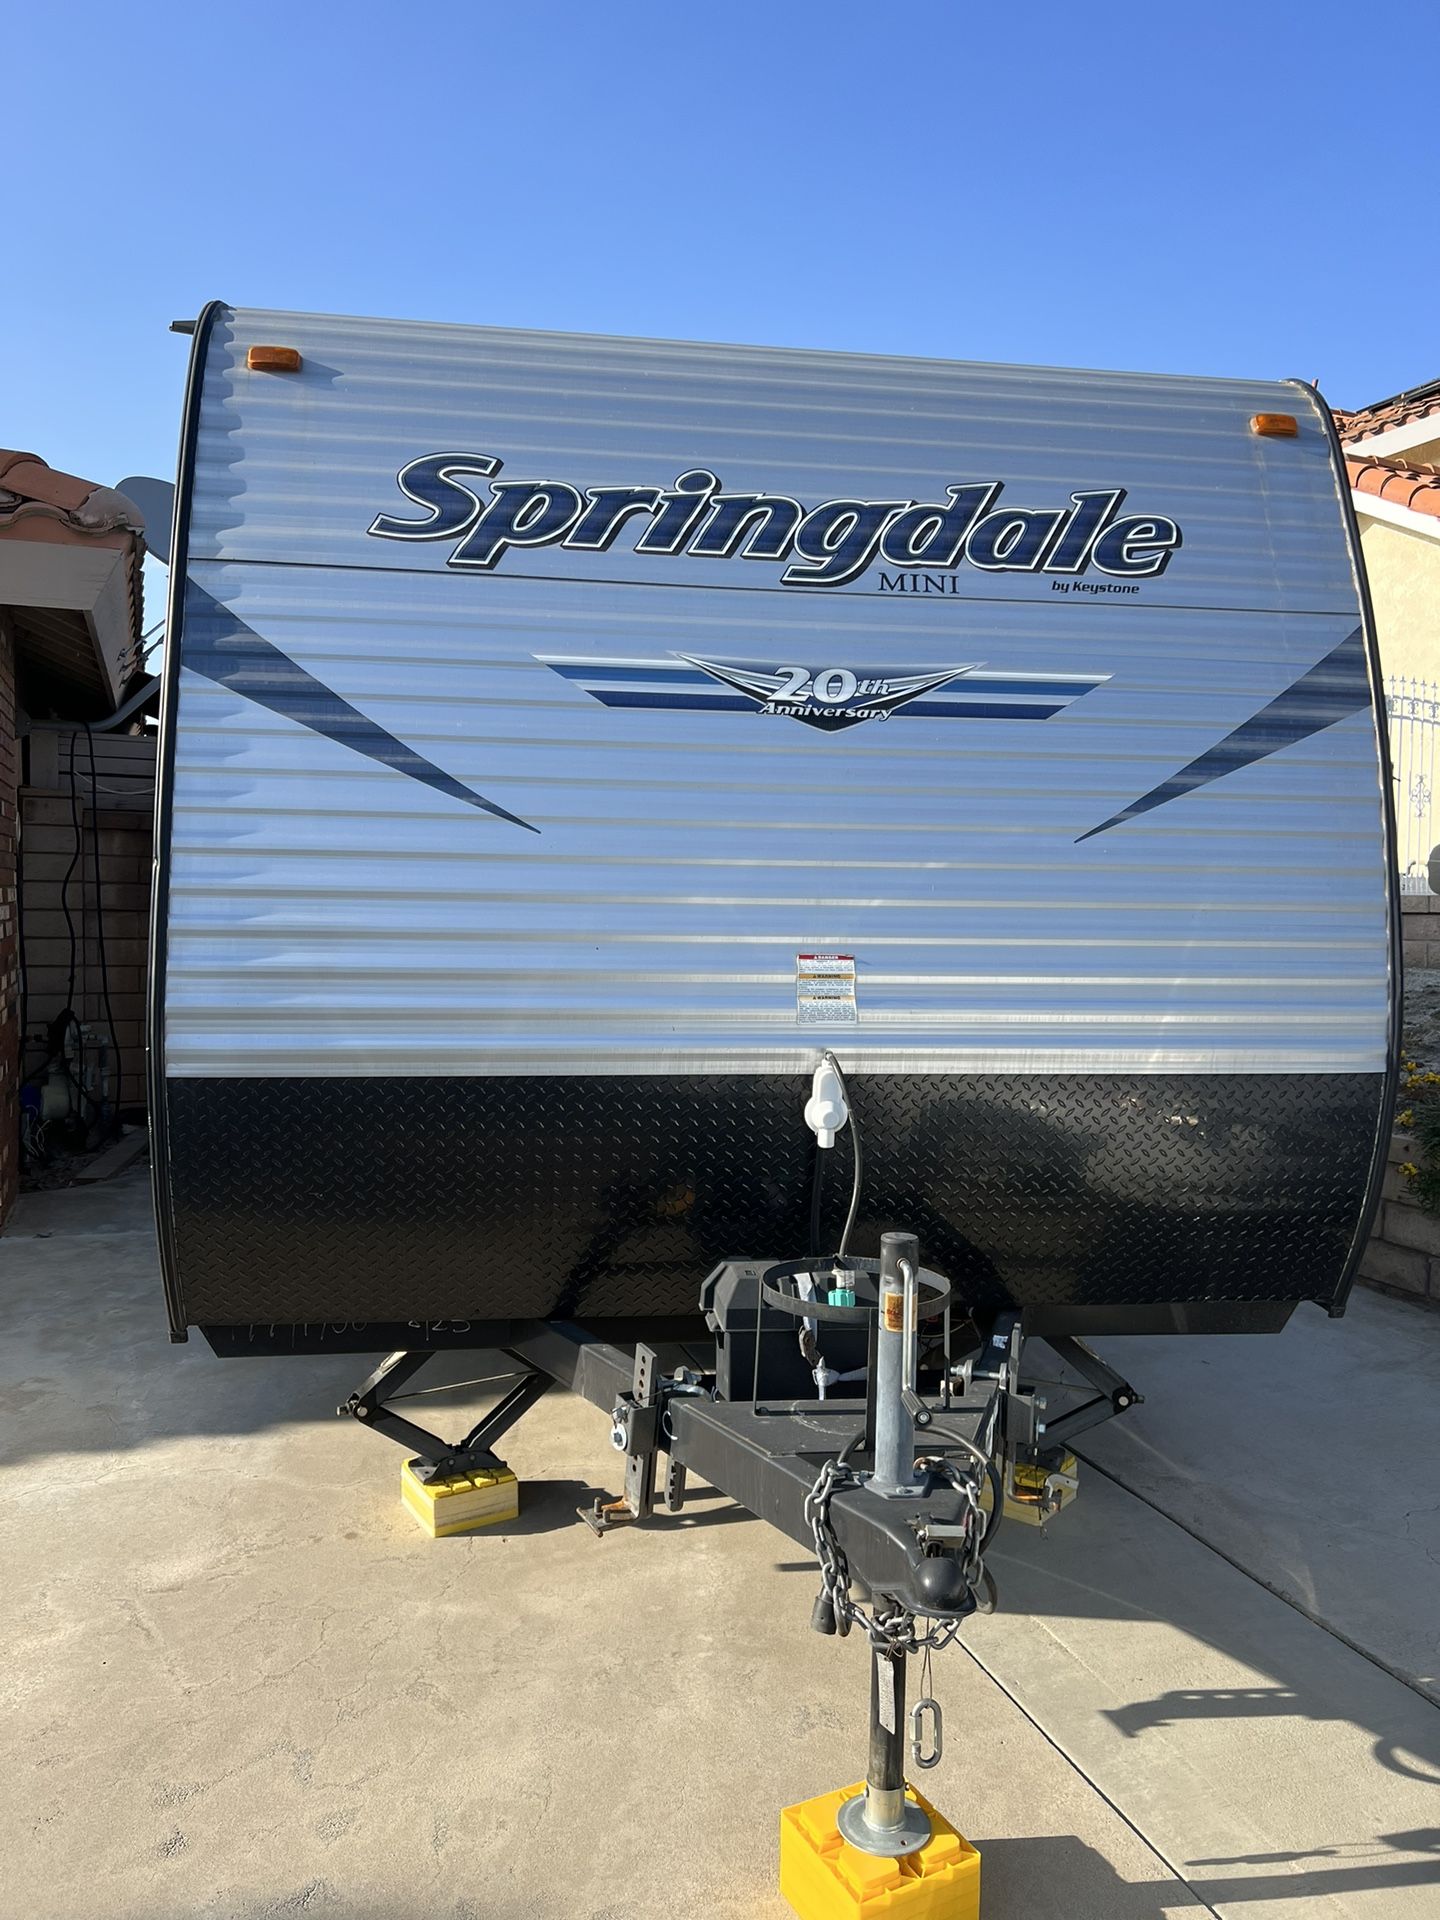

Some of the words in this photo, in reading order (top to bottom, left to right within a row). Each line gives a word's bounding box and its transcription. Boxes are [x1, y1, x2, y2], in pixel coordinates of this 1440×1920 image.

[368, 452, 1181, 586] Springdale
[878, 572, 960, 594] MINI
[1052, 580, 1069, 592] by
[1072, 581, 1140, 594] Keystone
[767, 667, 890, 704] 20th
[758, 702, 893, 721] Anniversary
